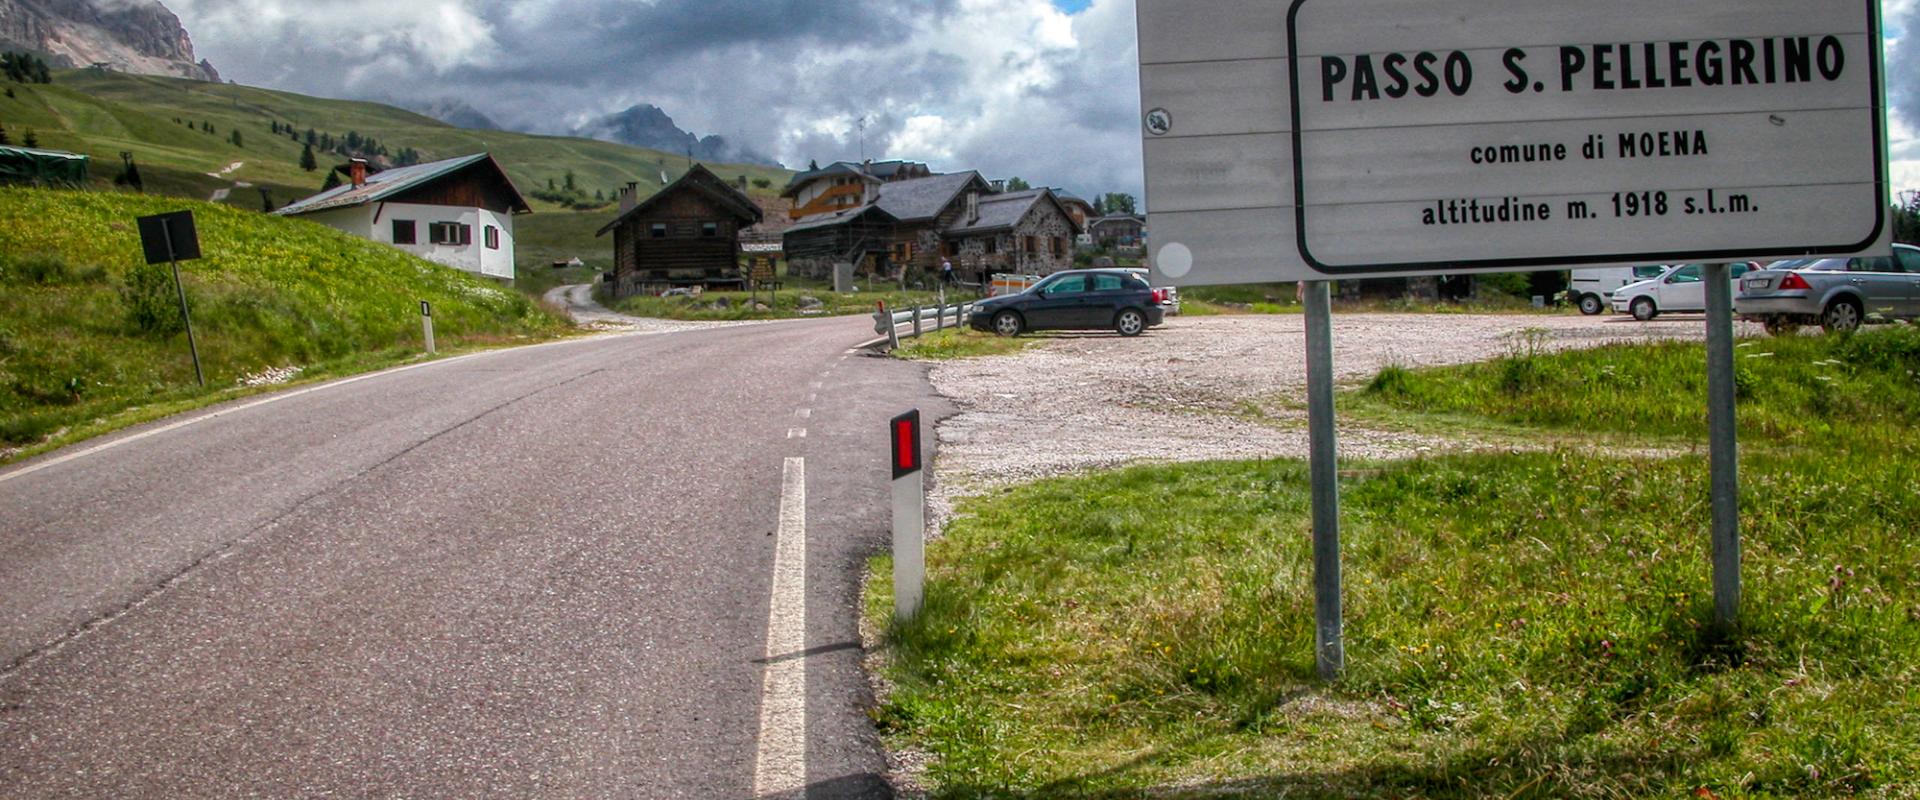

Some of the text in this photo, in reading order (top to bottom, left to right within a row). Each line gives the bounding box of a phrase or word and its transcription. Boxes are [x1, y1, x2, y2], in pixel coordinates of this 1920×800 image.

[1320, 34, 1845, 102] PASSO S. PELLEGRINO
[1469, 129, 1709, 165] comune di MOENA
[1421, 188, 1759, 226] altitudine m. 1918 s.l.m.
